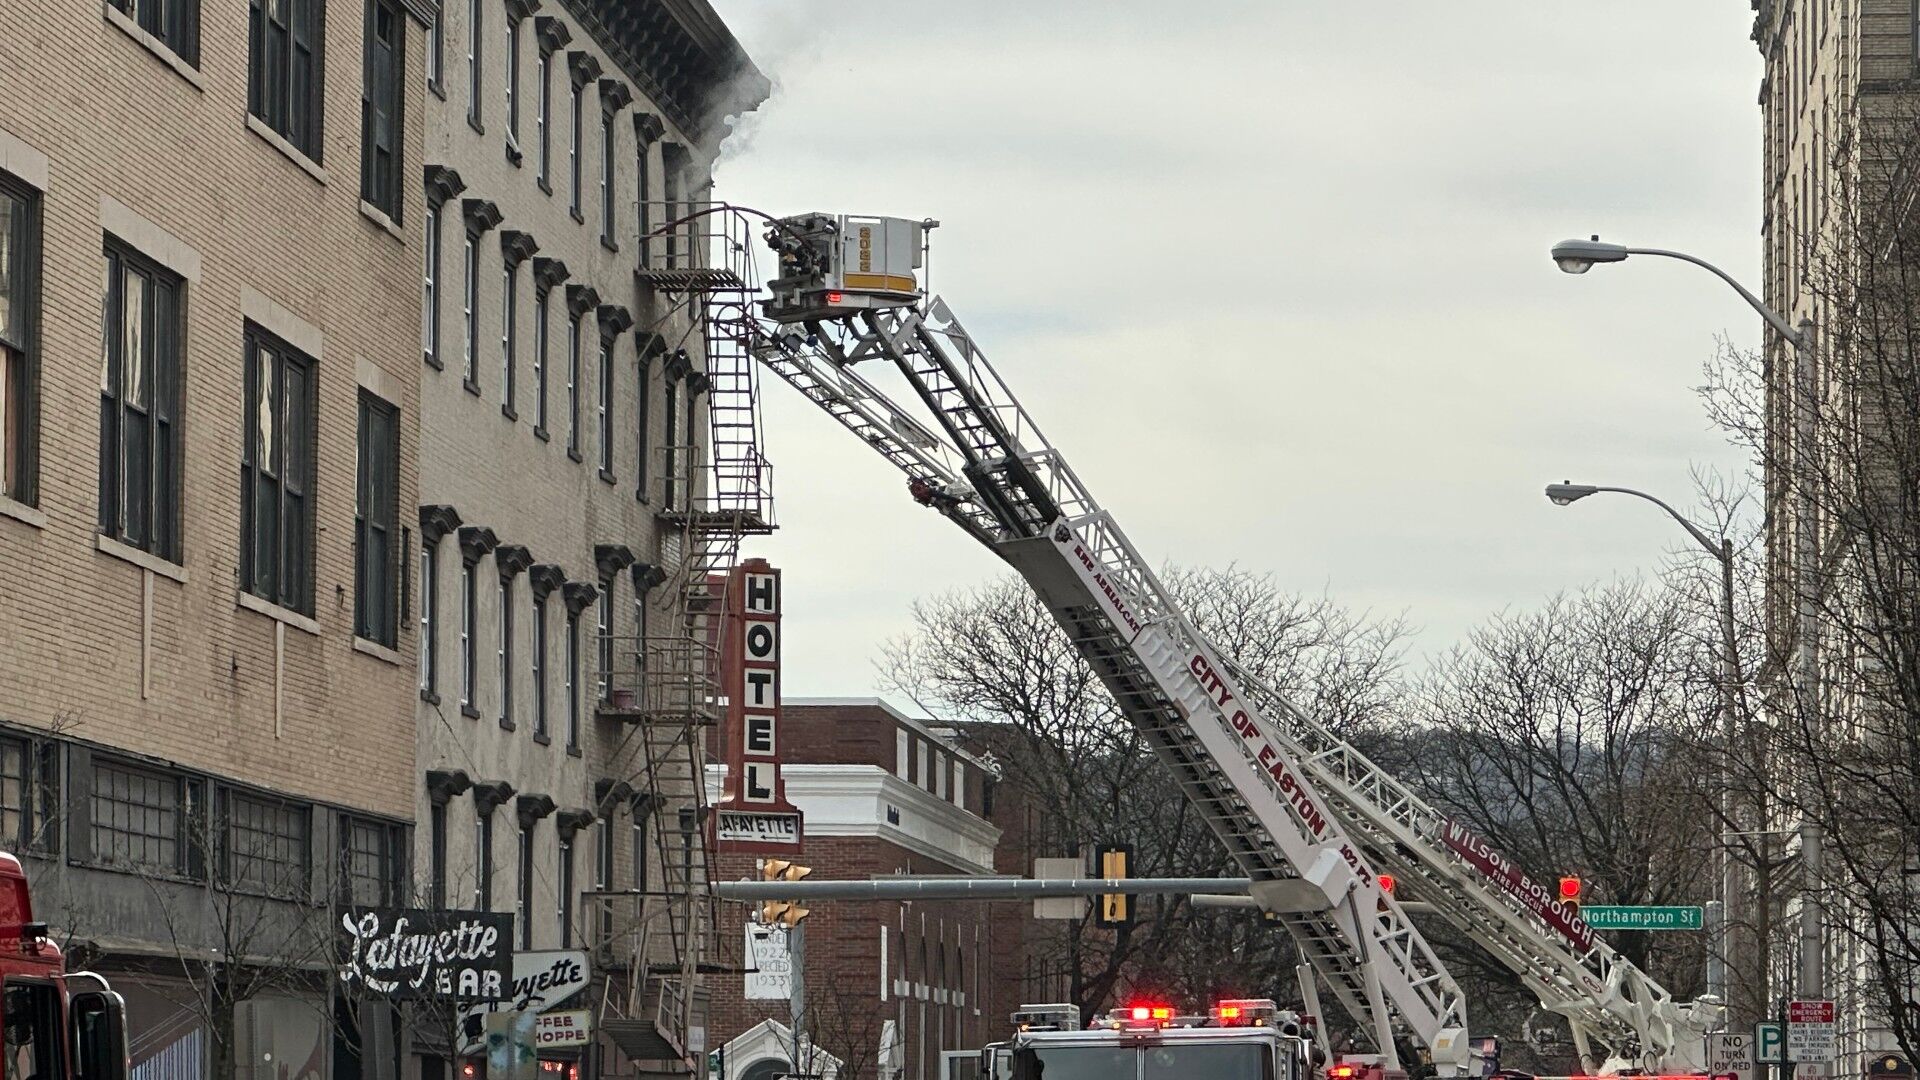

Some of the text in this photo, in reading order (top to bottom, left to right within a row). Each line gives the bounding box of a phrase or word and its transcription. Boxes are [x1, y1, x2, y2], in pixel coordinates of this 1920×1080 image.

[747, 576, 773, 799] HOTEL
[1190, 654, 1327, 837] CITY OF EASTON
[1339, 844, 1358, 868] 102
[1449, 821, 1593, 945] WILSON BOROUGH
[1582, 909, 1694, 925] Northampton St
[340, 912, 498, 993] Lafayette
[756, 947, 785, 958] 1922
[435, 967, 502, 997] BAR
[756, 975, 785, 986] 1933
[1723, 1036, 1742, 1047] NO
[1720, 1051, 1745, 1059] TURN
[1714, 1062, 1751, 1070] ON RED
